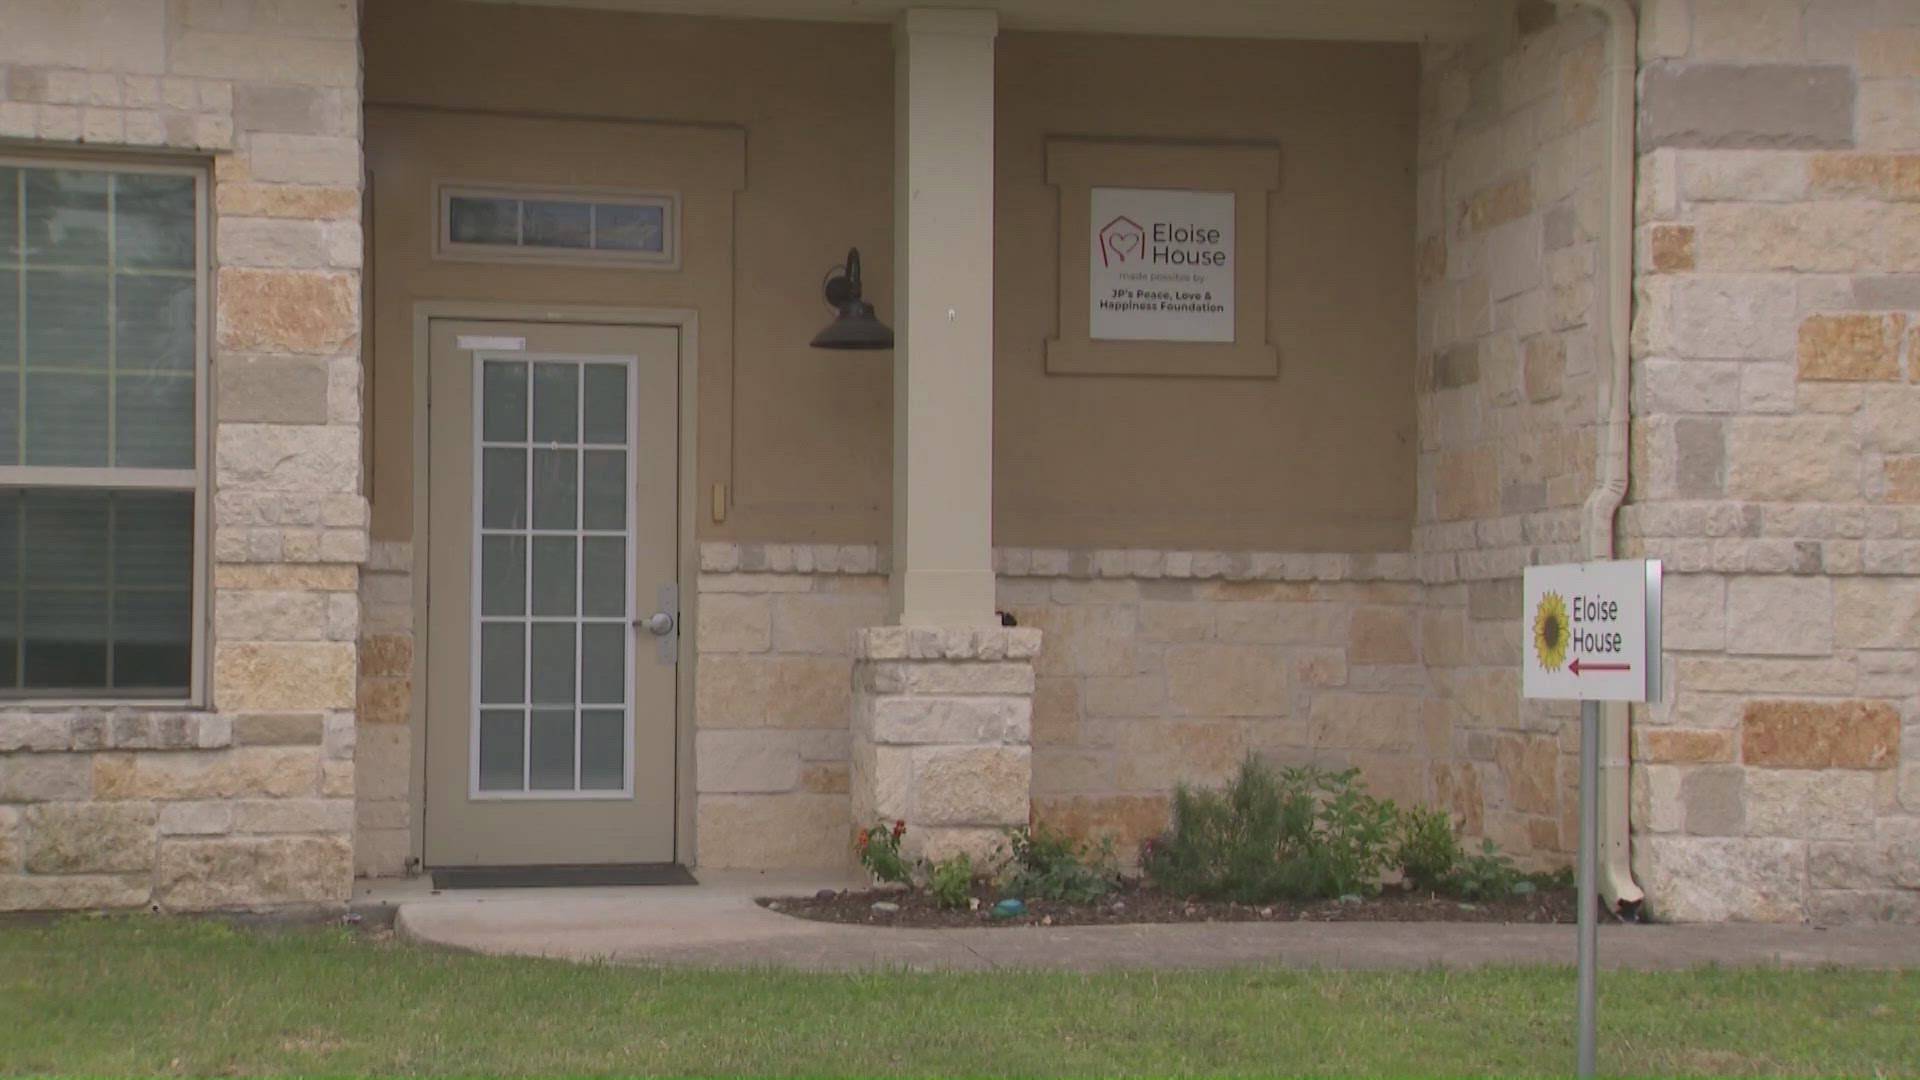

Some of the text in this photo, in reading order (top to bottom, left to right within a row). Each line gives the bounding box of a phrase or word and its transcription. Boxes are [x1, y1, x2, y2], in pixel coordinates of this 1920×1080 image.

[1153, 223, 1220, 244] Eloise
[1153, 246, 1226, 266] House
[1119, 272, 1205, 284] made possible by
[1112, 289, 1212, 301] JP's Peace, Love &
[1100, 300, 1224, 313] Happiness Foundation
[1573, 594, 1618, 622] Eloise
[1573, 627, 1622, 653] House
